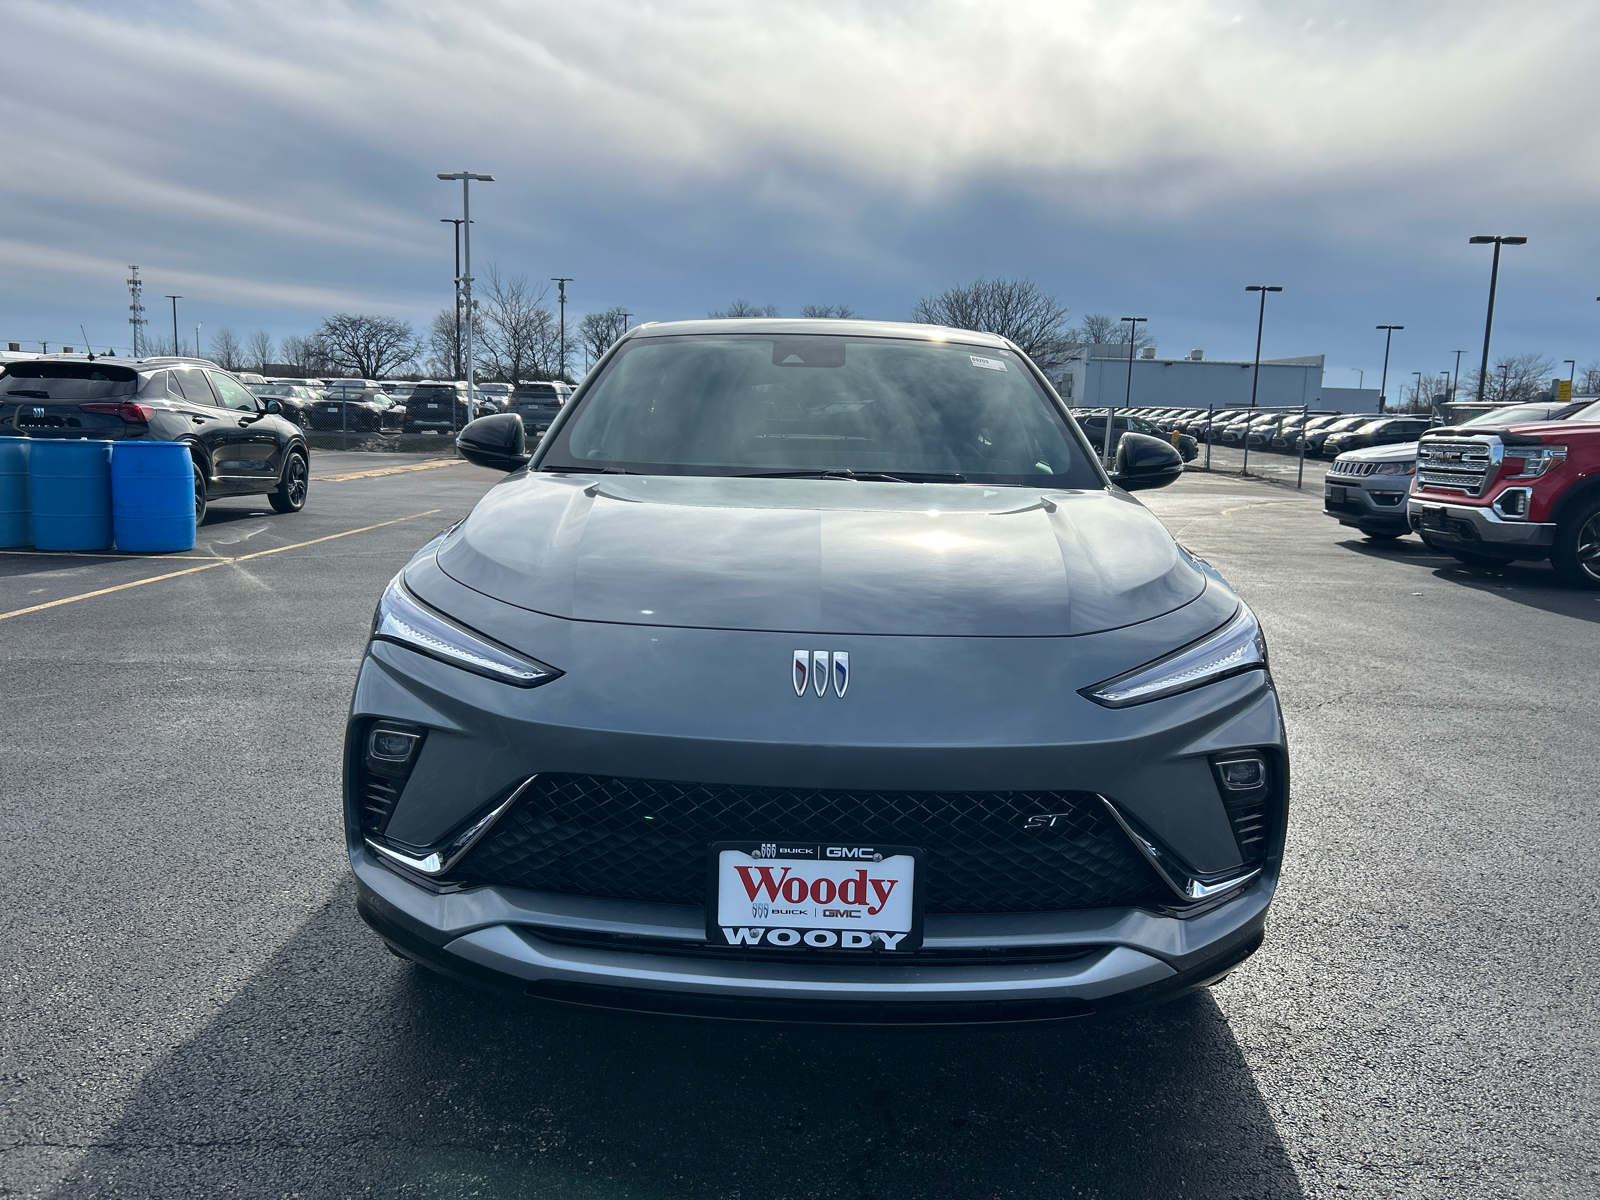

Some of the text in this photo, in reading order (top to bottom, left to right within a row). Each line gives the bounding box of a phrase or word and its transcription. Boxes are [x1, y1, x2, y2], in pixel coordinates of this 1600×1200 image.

[826, 847, 874, 858] GMC
[734, 866, 898, 915] Woody
[823, 909, 861, 918] GMC
[722, 928, 907, 950] WOODY
